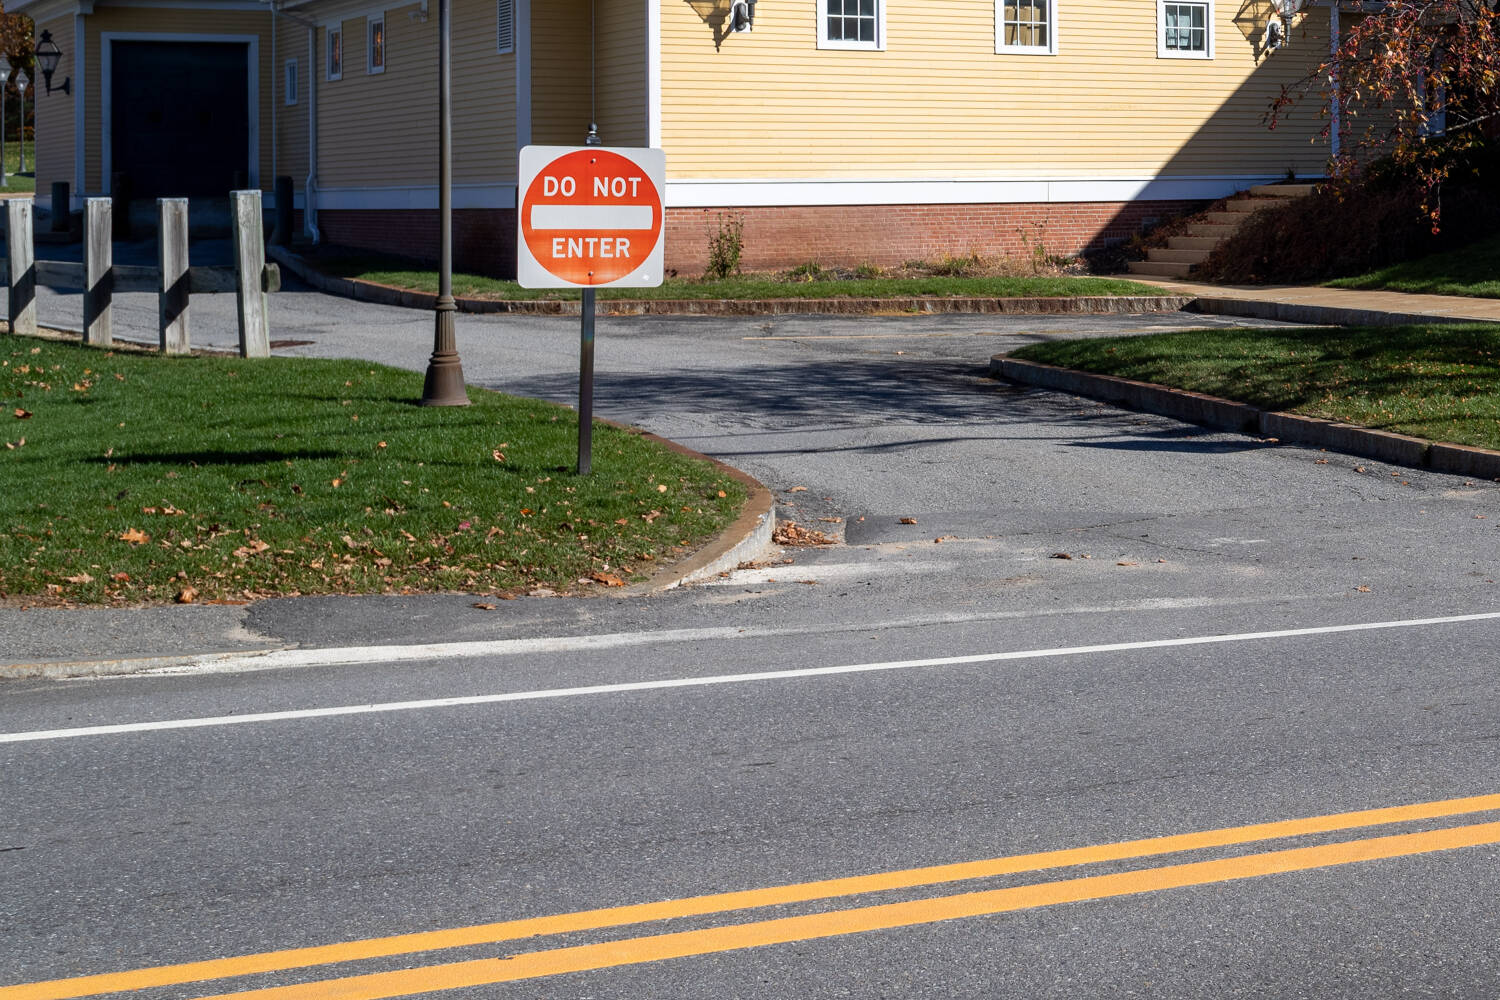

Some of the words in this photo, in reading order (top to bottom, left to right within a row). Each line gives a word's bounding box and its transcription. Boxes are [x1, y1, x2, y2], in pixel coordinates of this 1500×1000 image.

[543, 176, 576, 197] DO
[593, 176, 642, 197] NOT
[552, 237, 630, 258] ENTER
